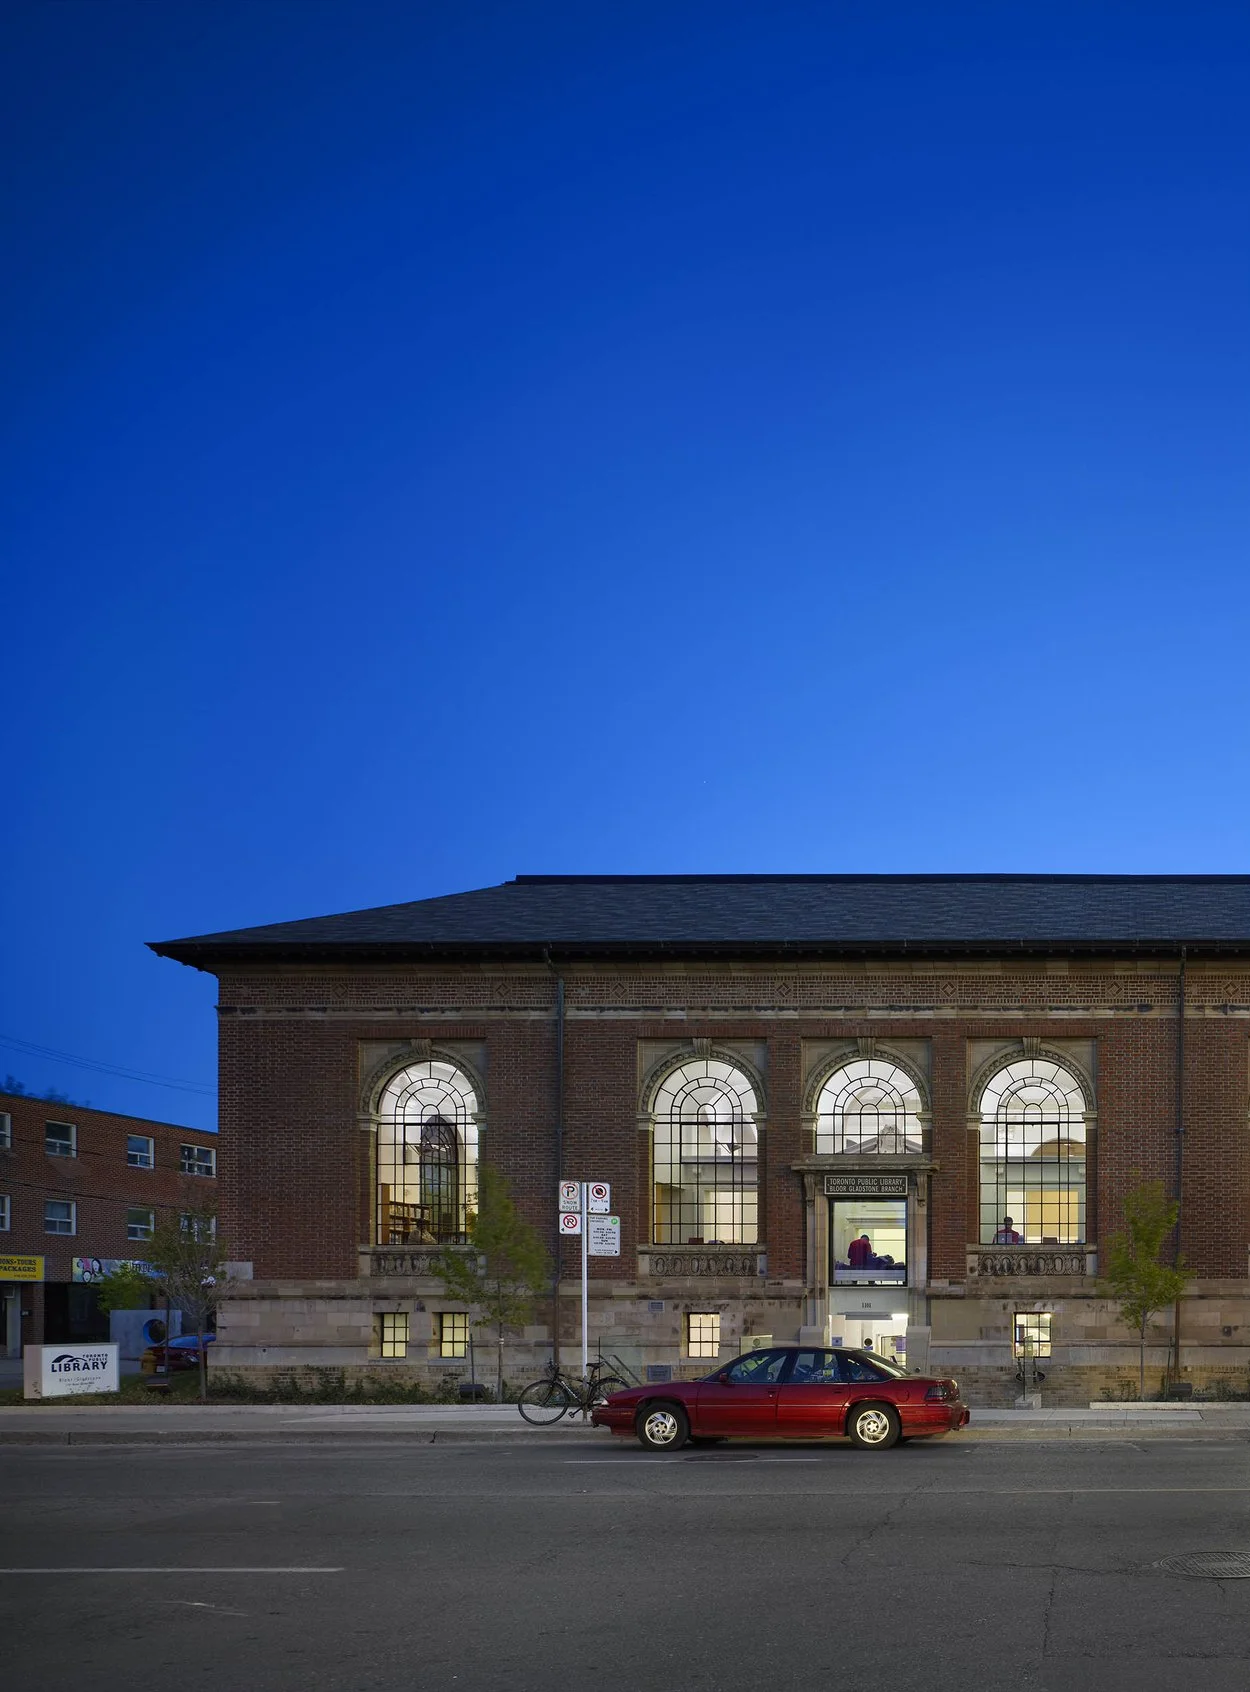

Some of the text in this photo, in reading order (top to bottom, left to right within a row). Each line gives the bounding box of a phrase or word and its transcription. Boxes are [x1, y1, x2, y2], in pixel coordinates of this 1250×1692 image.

[857, 1178, 877, 1186] PUBLIC
[880, 1178, 902, 1186] LIBRARY
[51, 1361, 107, 1373] LIBRARY
